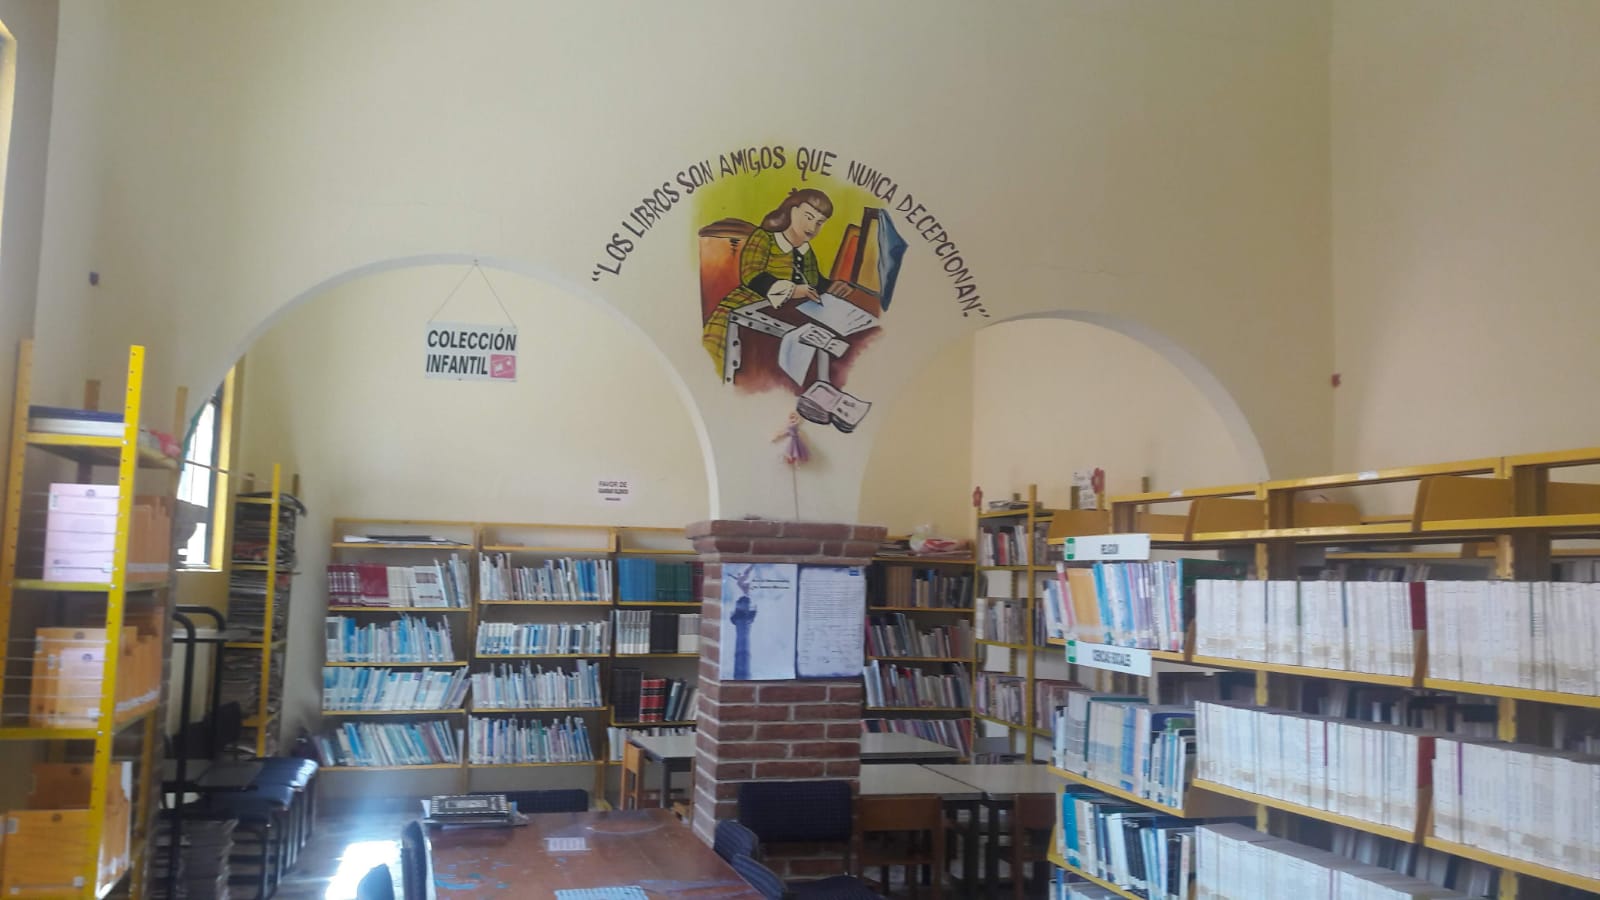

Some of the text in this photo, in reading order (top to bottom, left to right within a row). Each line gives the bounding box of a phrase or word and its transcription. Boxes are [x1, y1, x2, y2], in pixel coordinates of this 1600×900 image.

[621, 181, 680, 238] LIBROS
[676, 160, 715, 194] SON
[719, 145, 787, 178] AMIGOS
[796, 147, 838, 181] QUE
[846, 160, 899, 204] NUNCA
[427, 327, 518, 351] COLECCIÓN
[426, 354, 489, 375] INFANTIL
